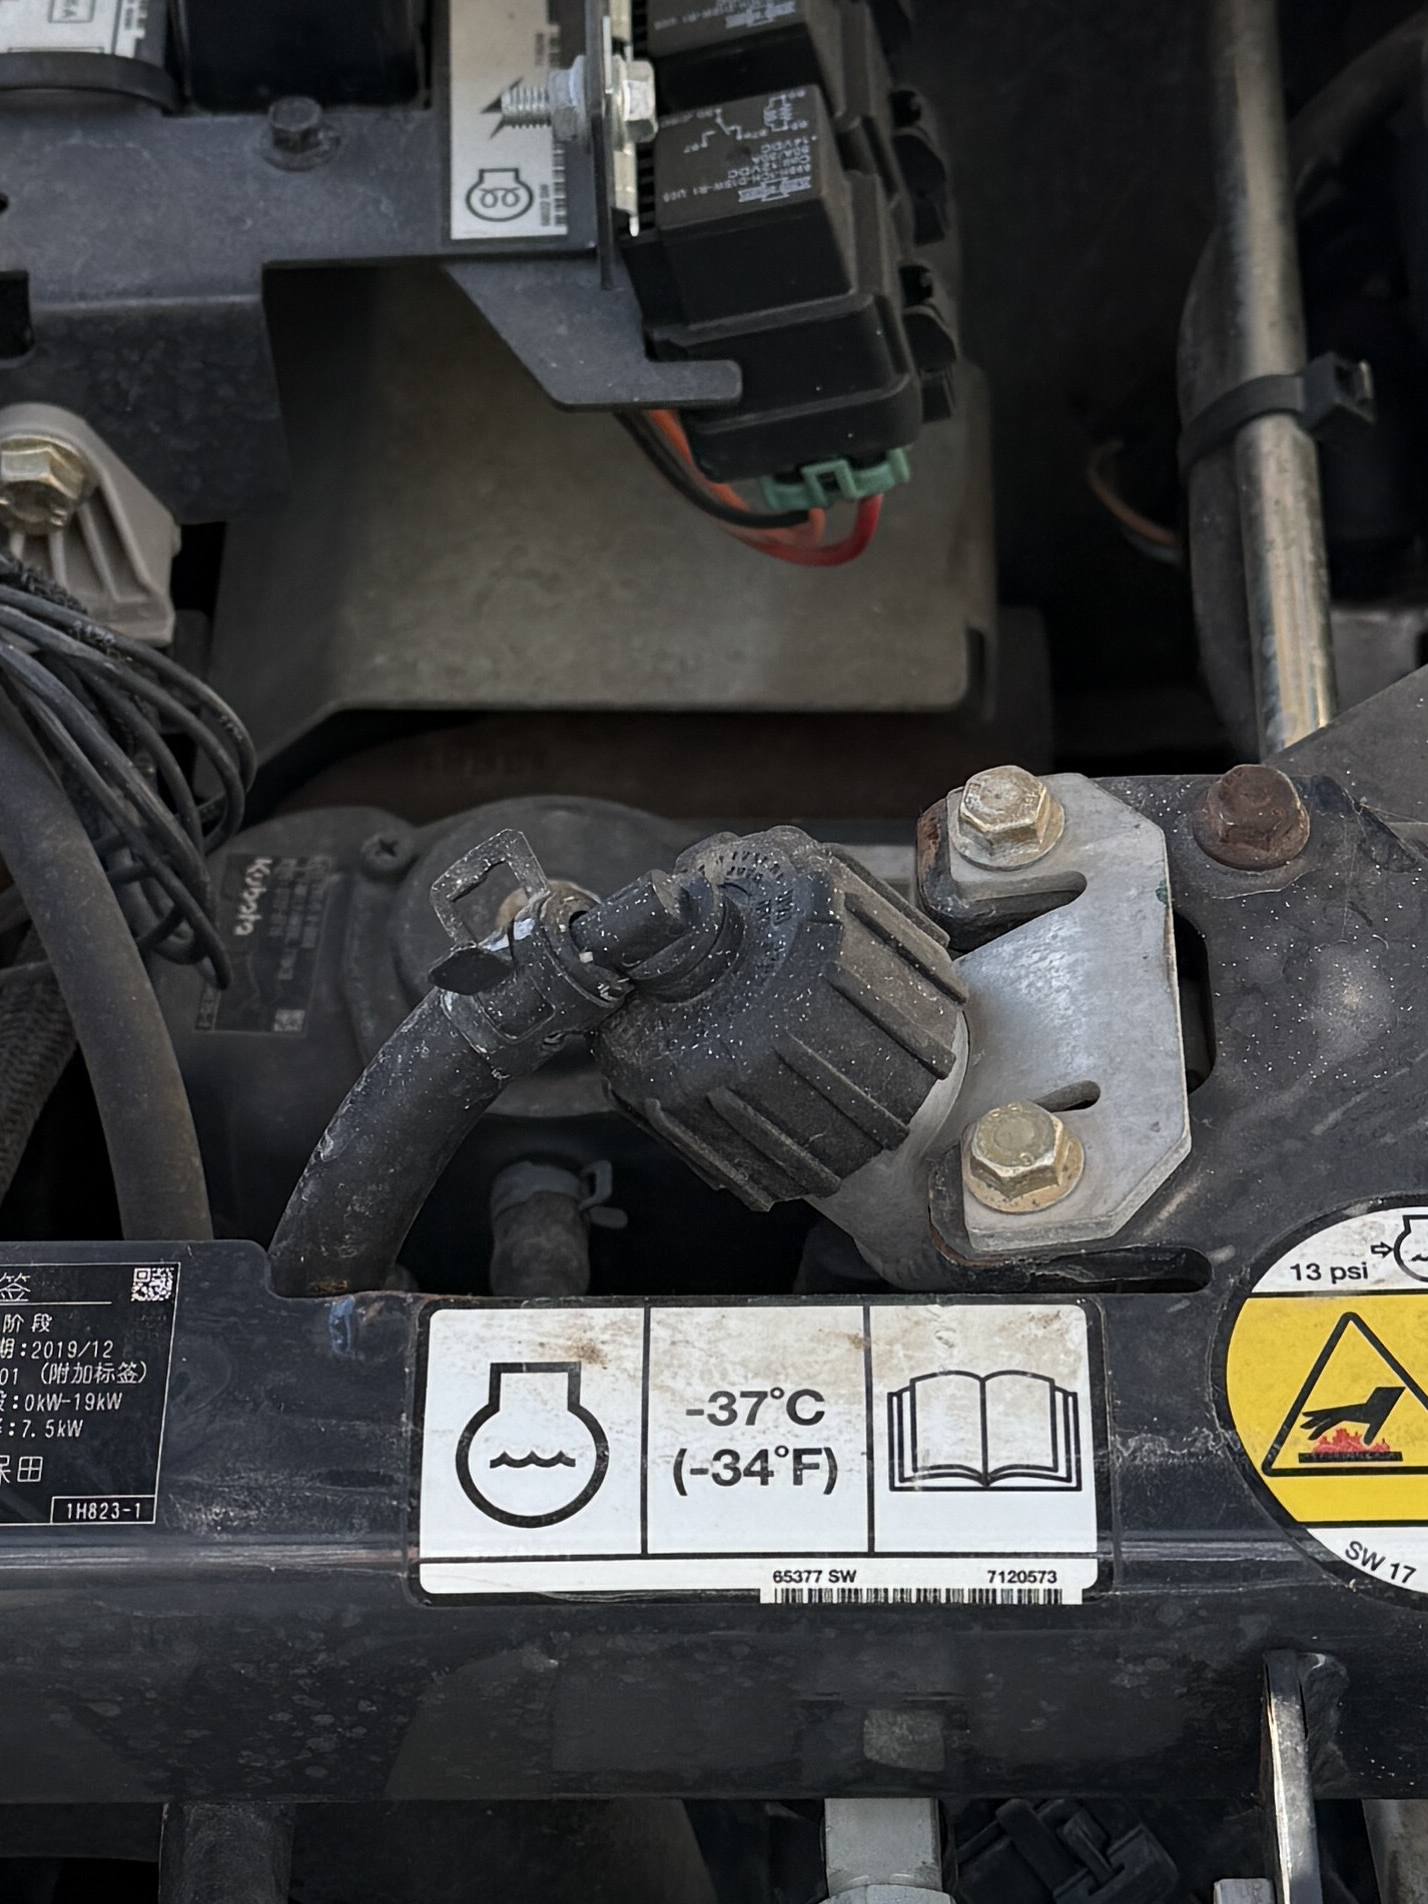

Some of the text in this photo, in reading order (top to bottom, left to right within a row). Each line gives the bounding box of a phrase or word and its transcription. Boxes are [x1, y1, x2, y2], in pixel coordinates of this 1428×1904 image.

[234, 856, 274, 937] Kubota
[1291, 1261, 1368, 1286] 13 psi
[684, 1388, 826, 1429] -37°C
[672, 1446, 839, 1496] (-34°F)
[64, 1500, 143, 1521] 1H823-1
[772, 1569, 858, 1585] 65377 SW
[986, 1568, 1059, 1585] 7120573
[1344, 1540, 1417, 1585] SW 17
